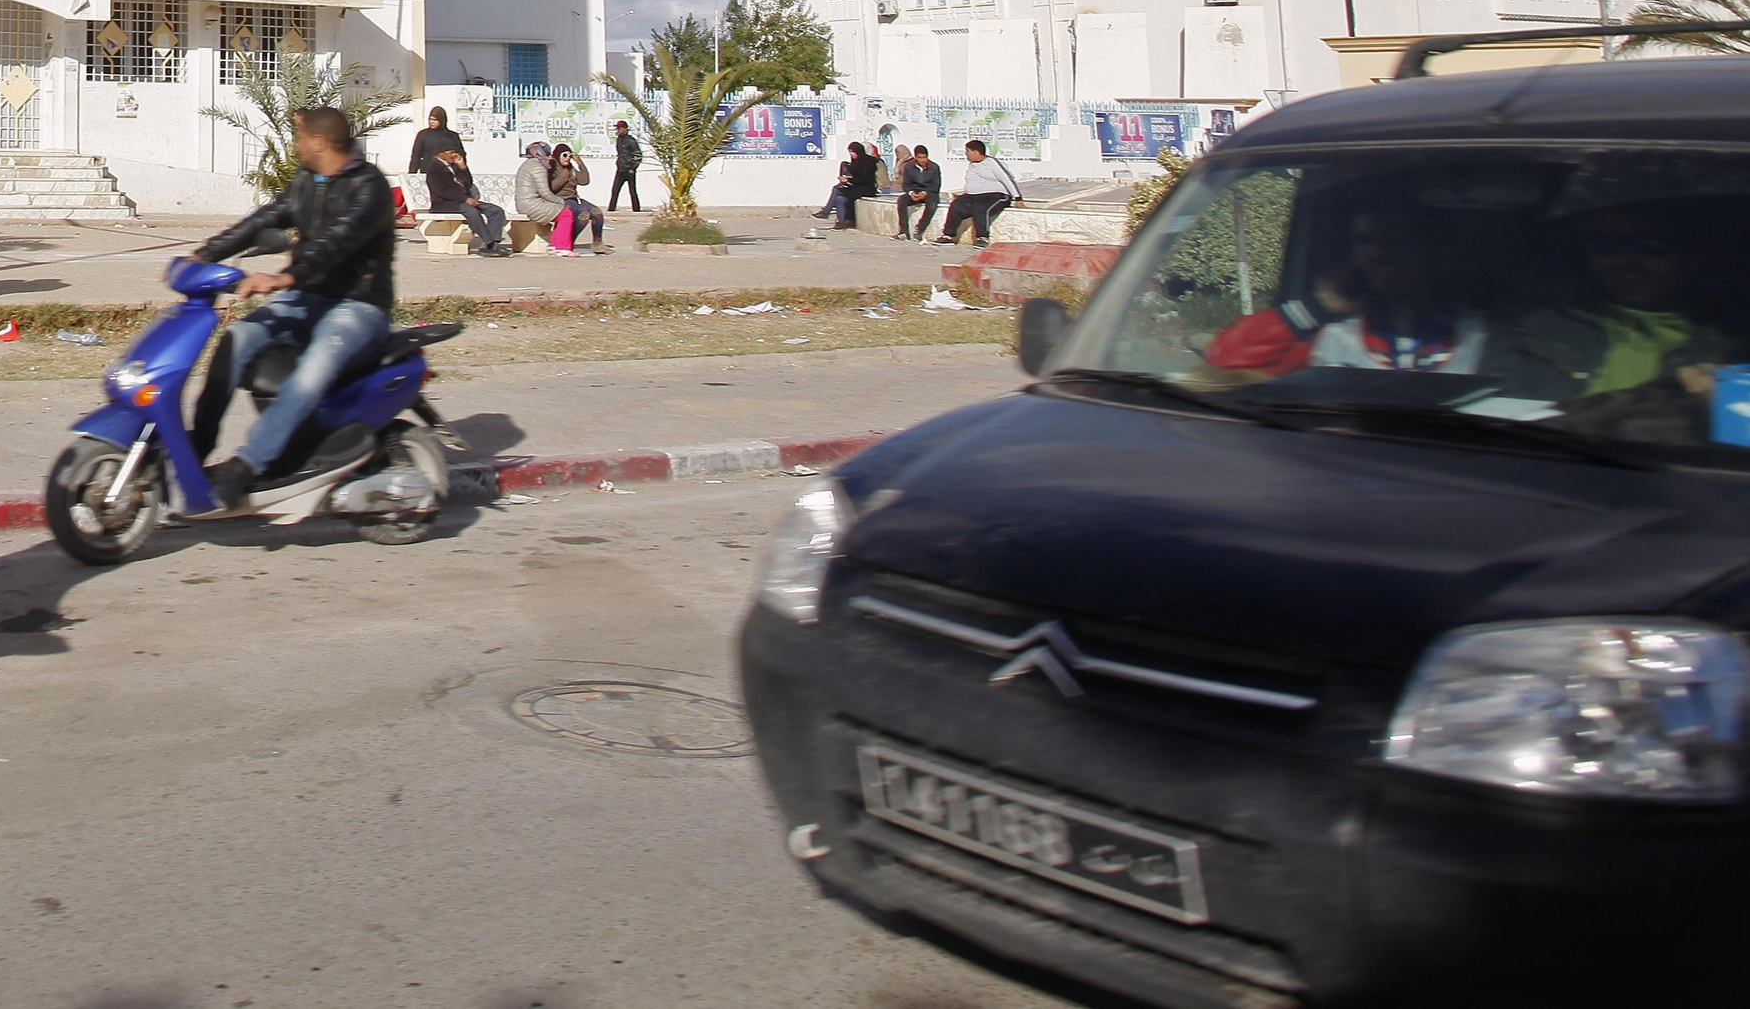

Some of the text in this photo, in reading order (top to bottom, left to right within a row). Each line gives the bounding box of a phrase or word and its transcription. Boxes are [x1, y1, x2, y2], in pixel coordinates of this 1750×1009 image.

[743, 108, 775, 138] 11
[783, 118, 813, 130] BONUS
[1118, 115, 1144, 142] 11
[1151, 124, 1175, 134] BONUS
